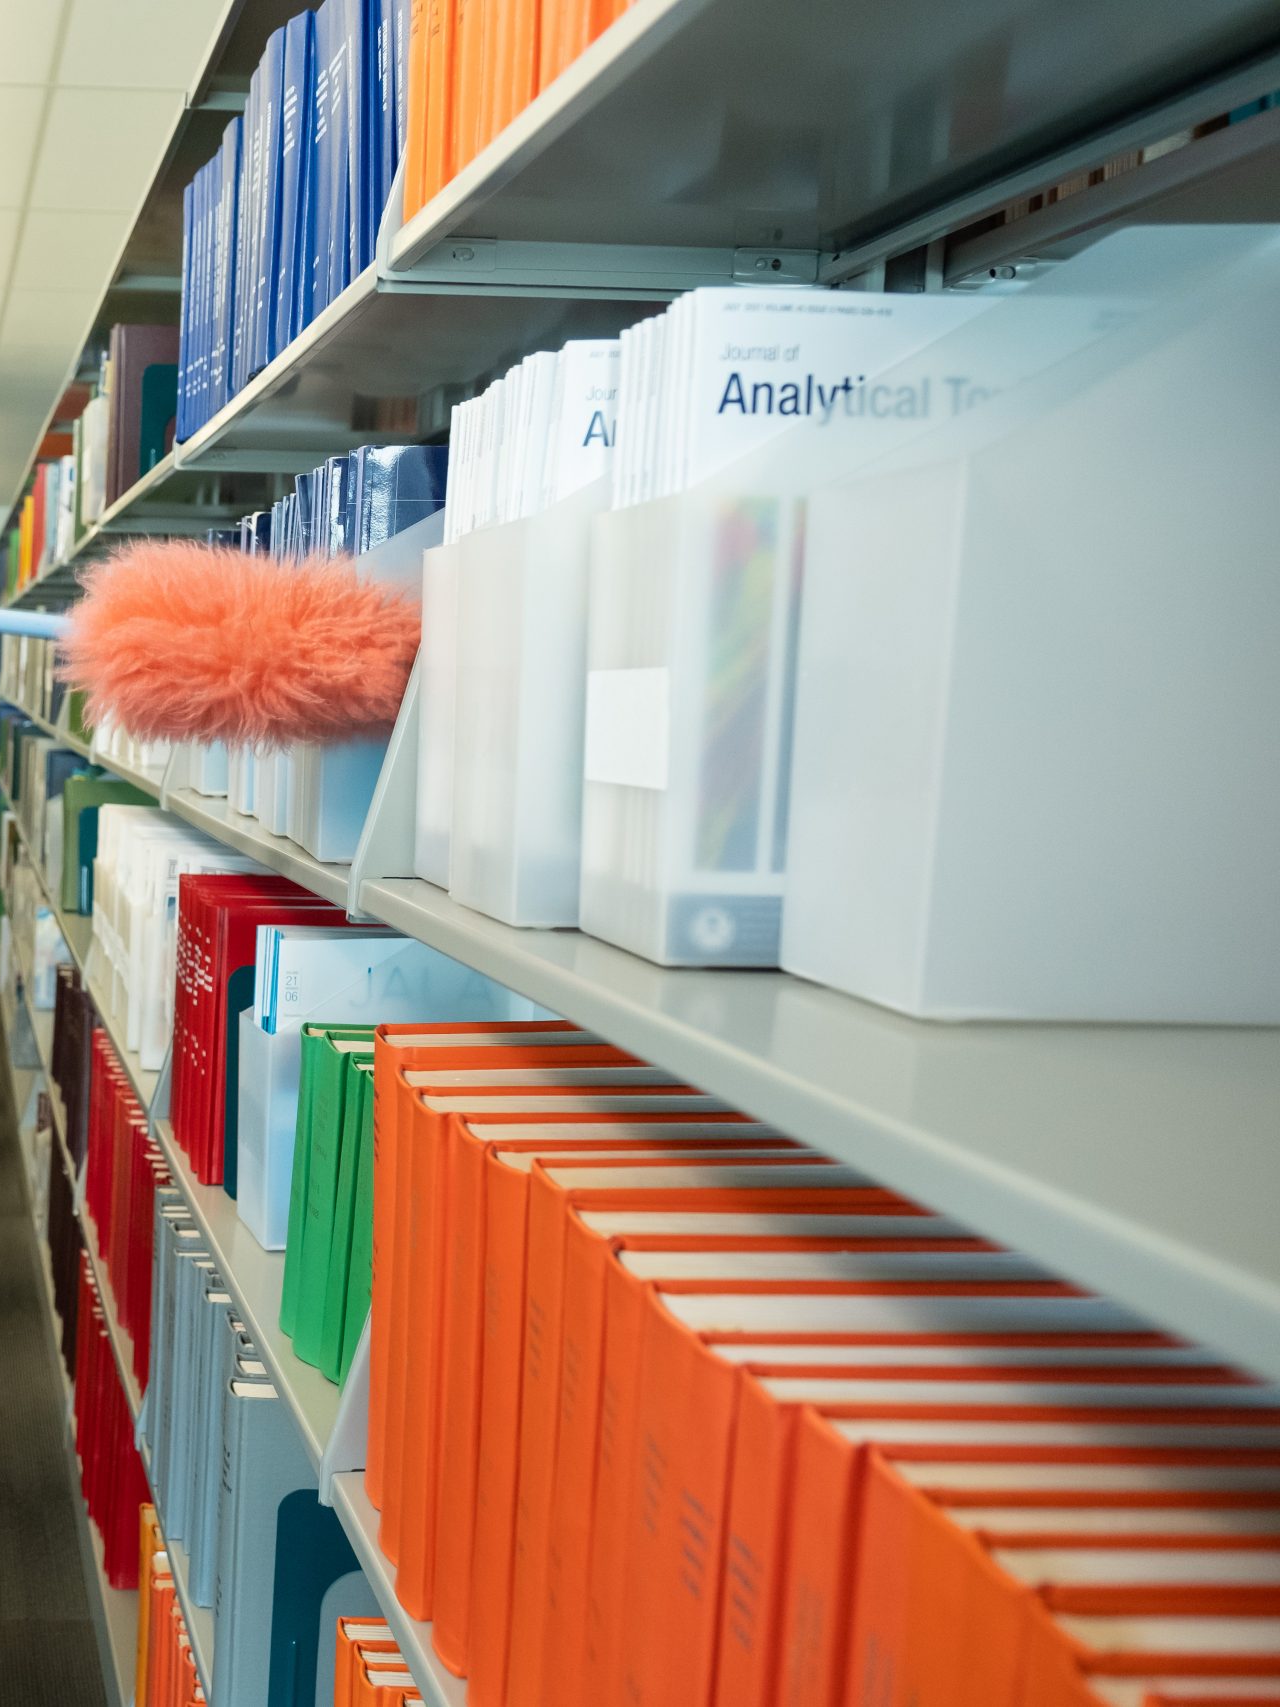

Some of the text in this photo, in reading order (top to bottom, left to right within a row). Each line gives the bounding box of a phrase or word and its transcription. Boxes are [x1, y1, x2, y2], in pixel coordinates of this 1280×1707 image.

[719, 342, 801, 362] Journal of
[717, 371, 931, 426] Analytical
[285, 975, 297, 986] 21
[285, 991, 298, 1002] 06
